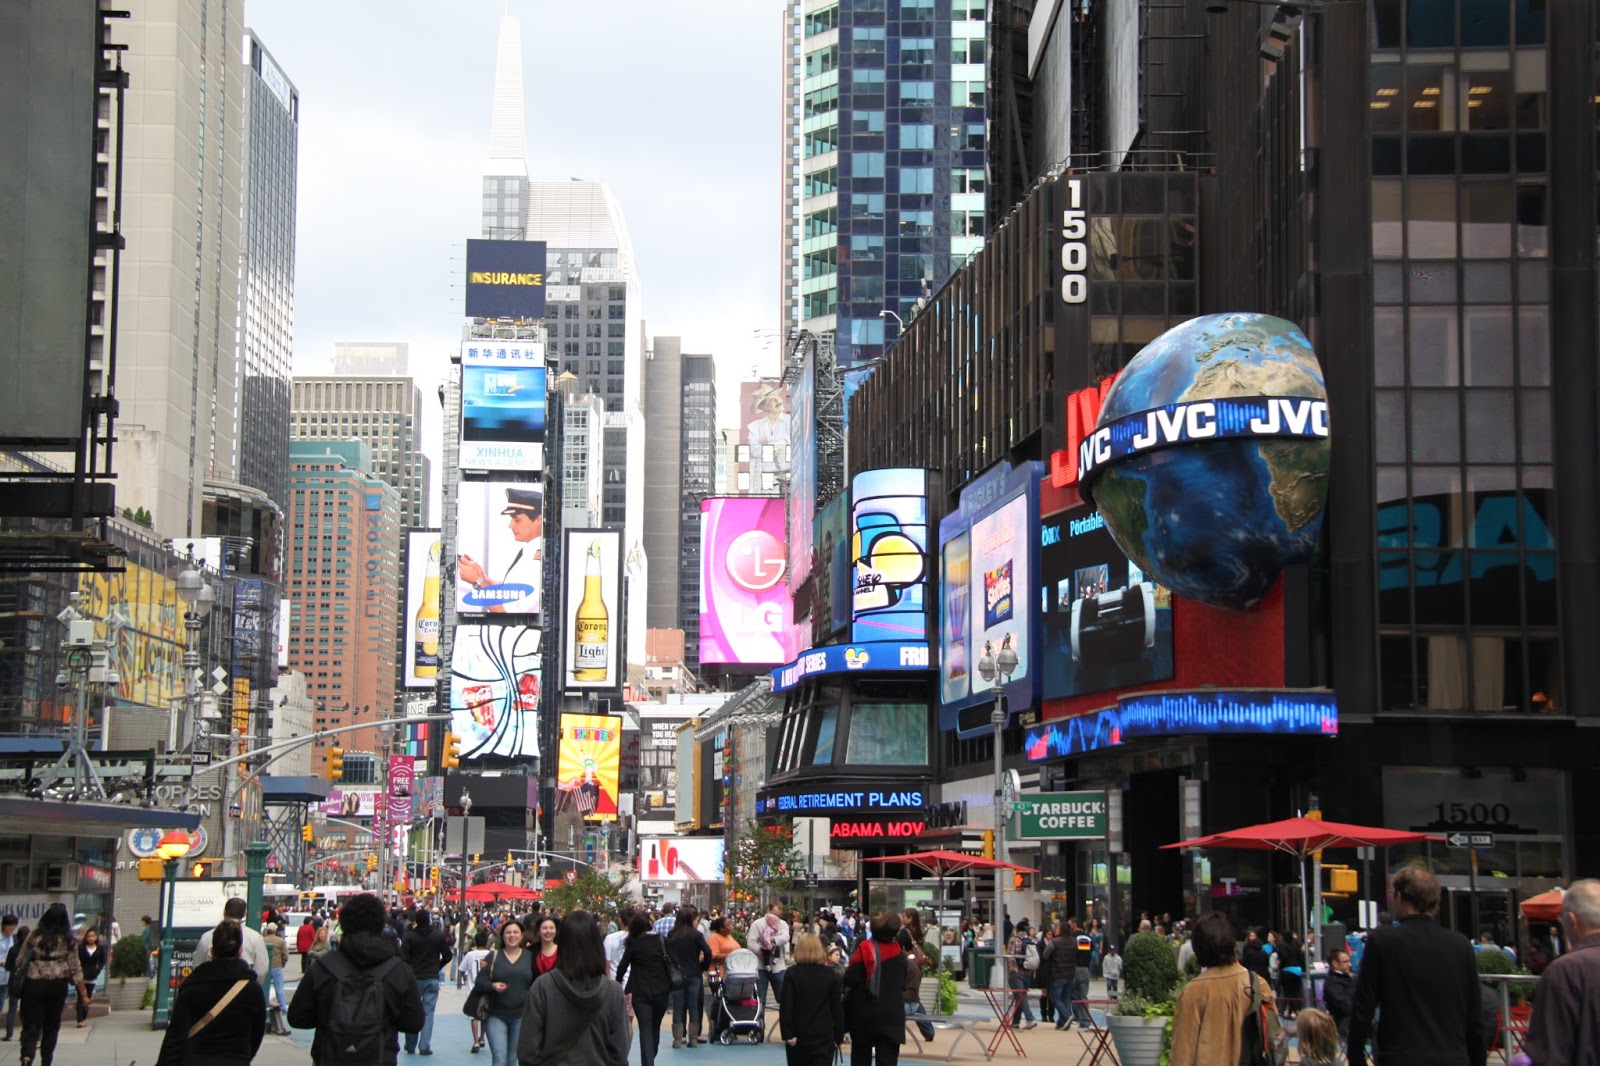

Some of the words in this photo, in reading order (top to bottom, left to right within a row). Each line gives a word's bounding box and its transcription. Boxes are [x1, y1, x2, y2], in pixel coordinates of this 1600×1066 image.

[1062, 180, 1087, 304] 1500
[468, 348, 535, 359] 新华通讯社
[1250, 399, 1328, 437] JVC
[1133, 402, 1216, 450] JVC
[476, 448, 524, 458] XINHUA
[1079, 426, 1111, 481] JVC
[365, 514, 378, 617] NOVOTEL
[471, 589, 526, 600] SAMSUNG
[418, 619, 438, 628] Coro
[578, 621, 607, 632] Corona
[579, 645, 605, 658] Light
[806, 652, 826, 674] SERIES
[393, 777, 410, 785] FREE
[151, 785, 222, 800] ORCES
[778, 795, 798, 810] FEDERAL
[799, 793, 864, 808] RETIREMENT
[869, 792, 922, 806] PLANS
[1434, 803, 1510, 825] 1500
[1039, 816, 1095, 828] COFFEE
